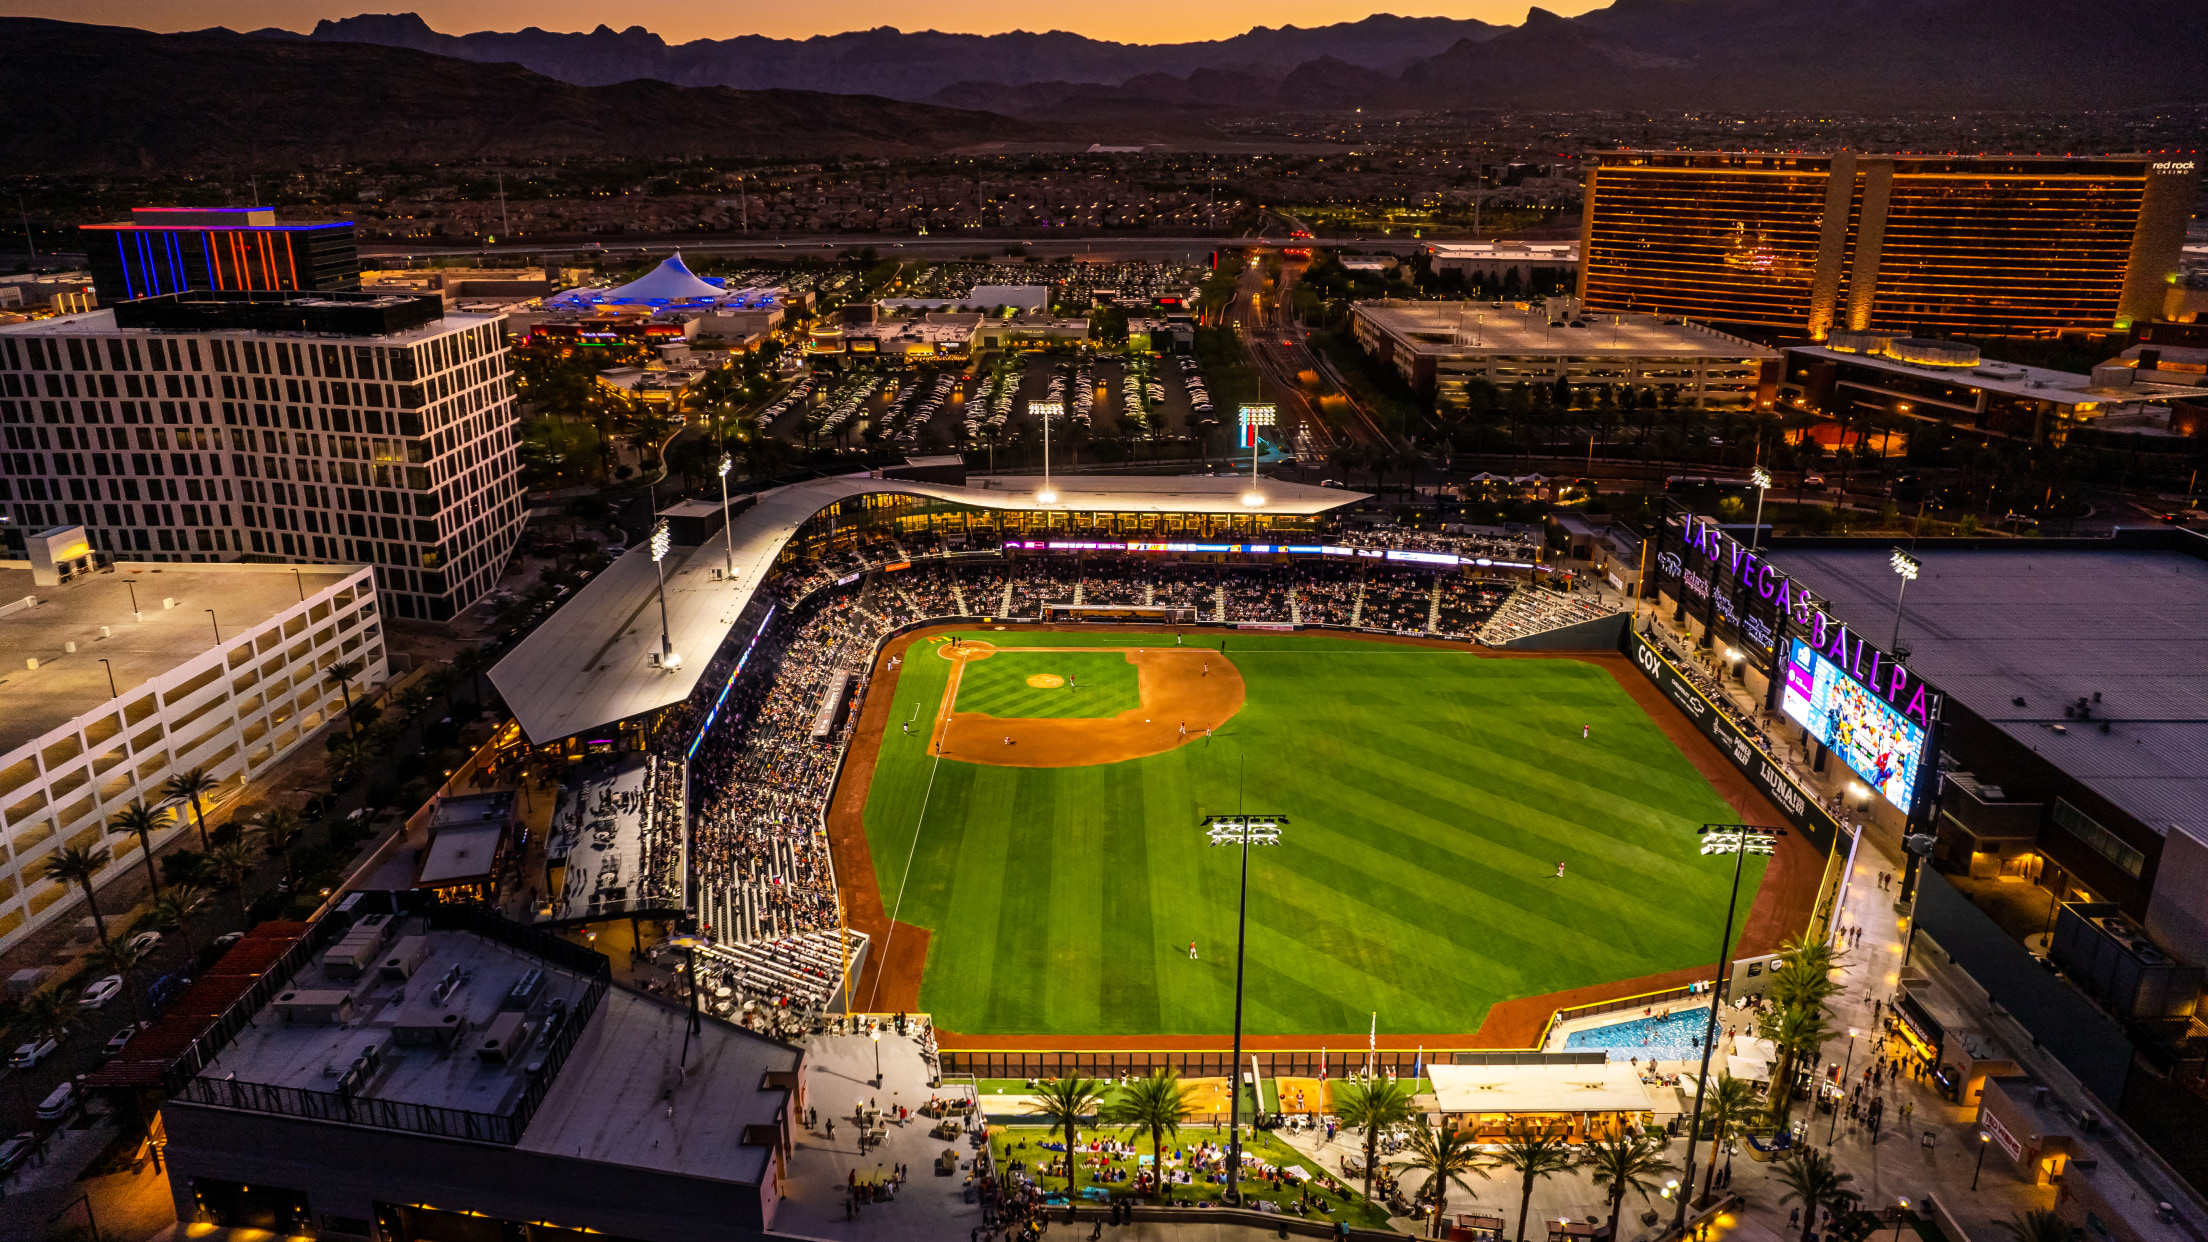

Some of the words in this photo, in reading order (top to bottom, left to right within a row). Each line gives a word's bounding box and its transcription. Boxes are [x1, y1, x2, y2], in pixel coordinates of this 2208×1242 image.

[2152, 161, 2171, 170] red
[2171, 161, 2195, 170] rock
[1684, 513, 1722, 562] LAS
[1731, 541, 1811, 624] VEGAS
[1638, 644, 1661, 679] COX
[1733, 748, 1750, 766] ALLEY
[1734, 736, 1752, 759] POWER
[1986, 1111, 1998, 1130] TED
